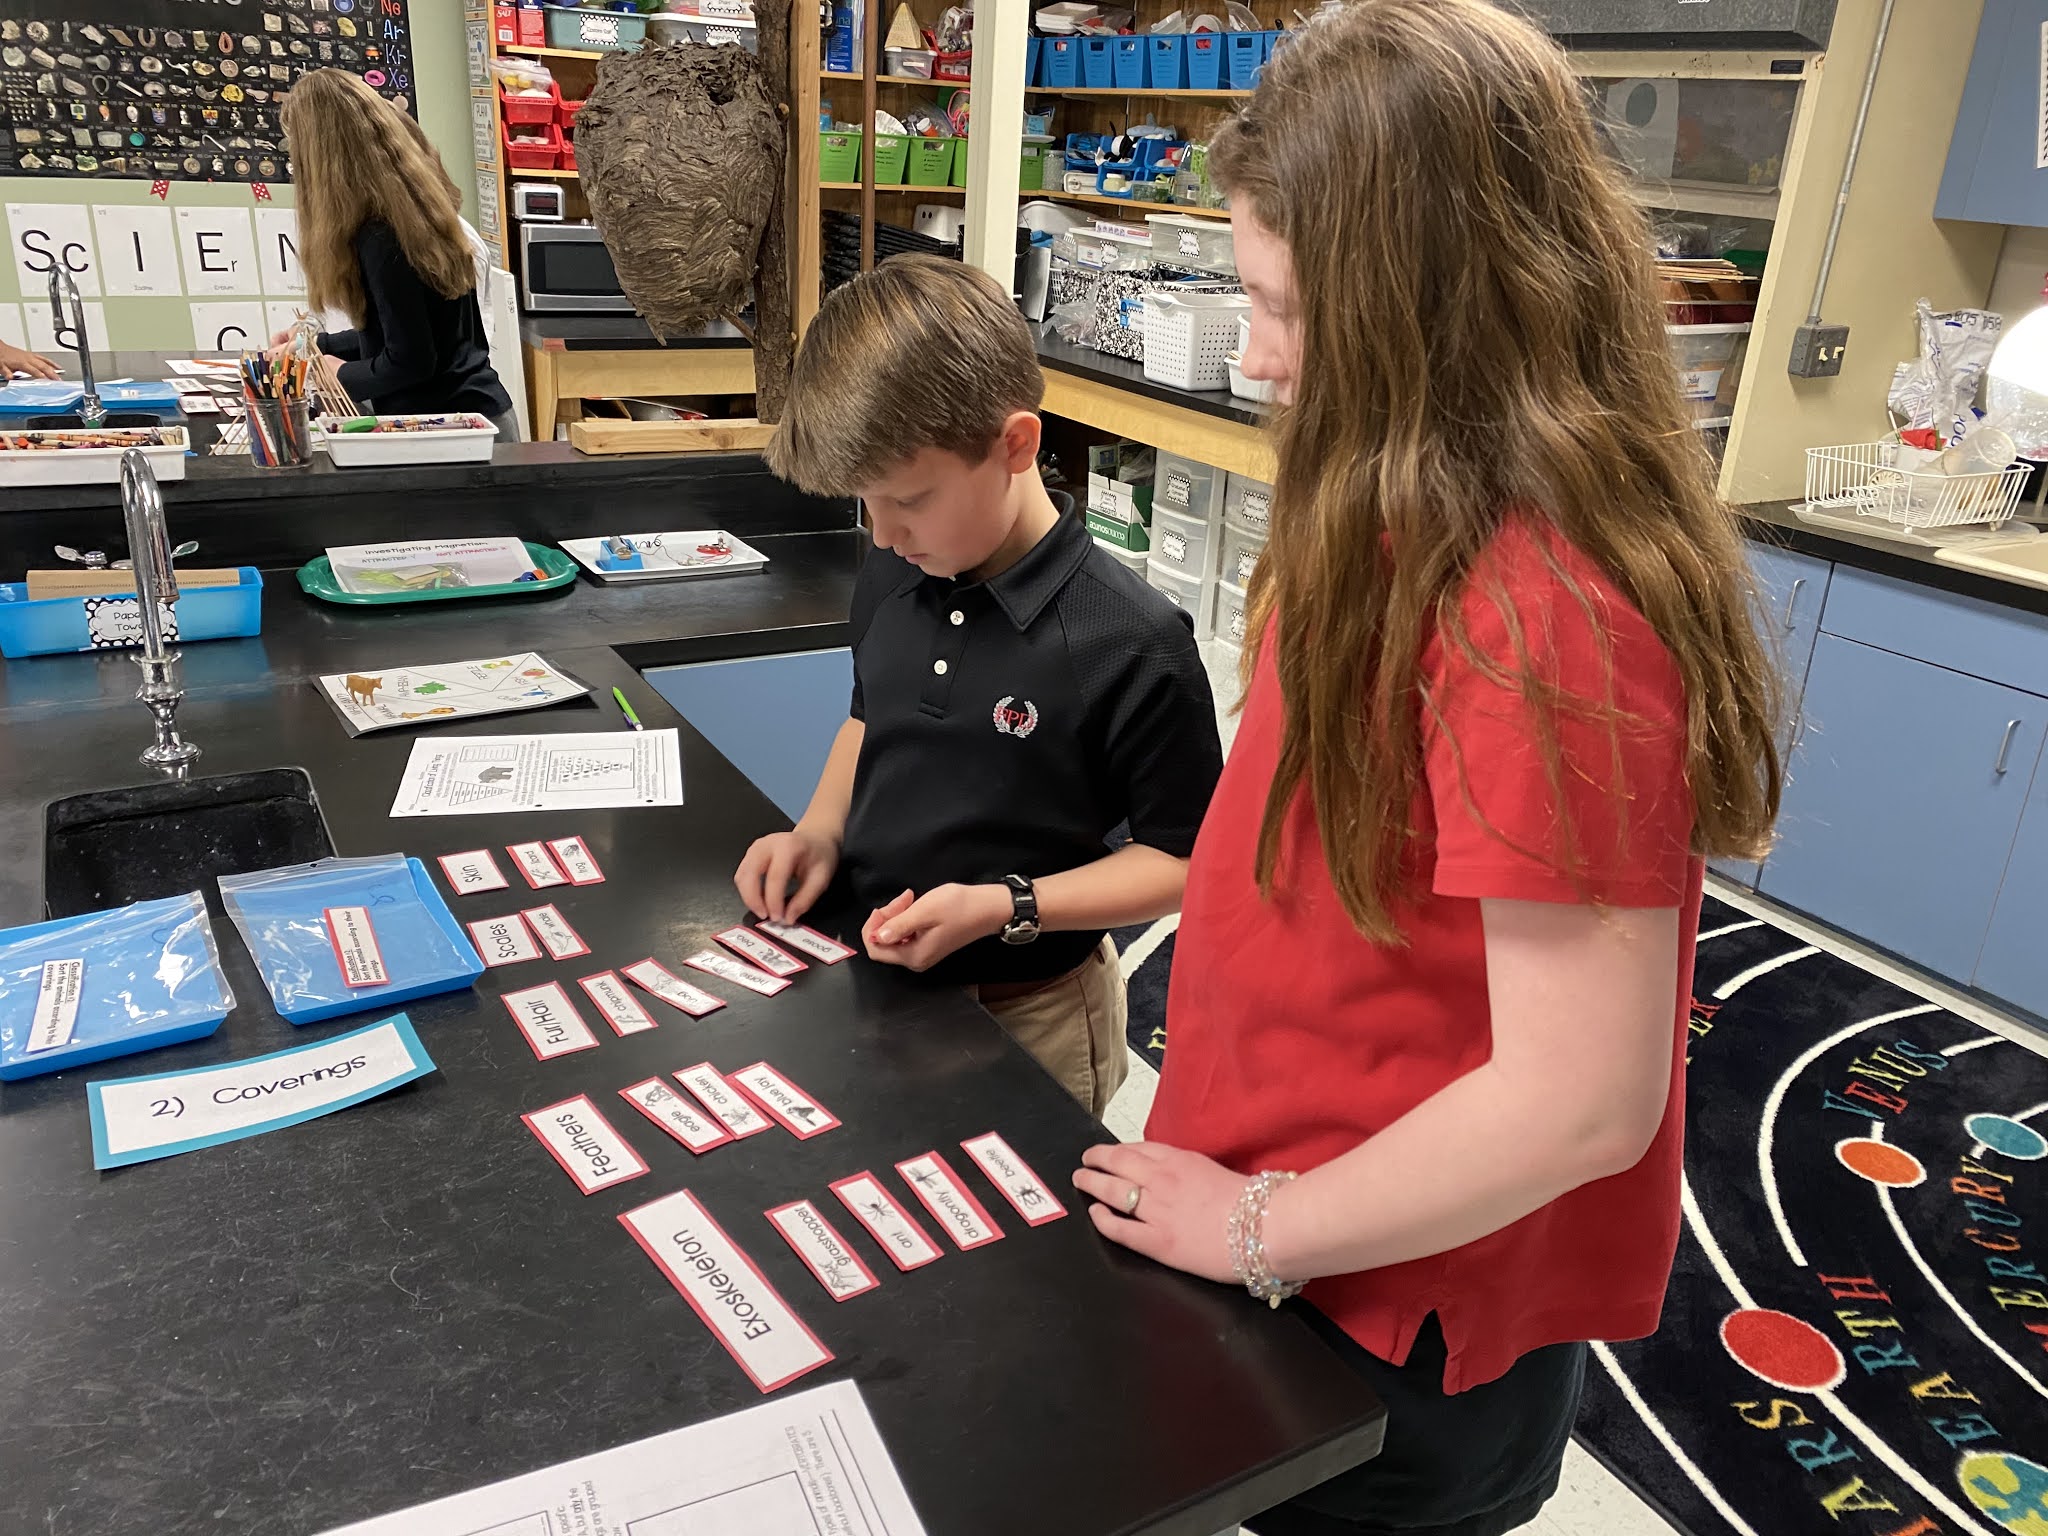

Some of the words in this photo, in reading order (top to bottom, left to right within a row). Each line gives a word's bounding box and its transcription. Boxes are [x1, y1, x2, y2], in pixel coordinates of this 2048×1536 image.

[496, 9, 512, 18] SALT
[383, 18, 405, 40] Ar
[385, 43, 407, 65] Kr
[388, 67, 409, 89] Xe
[20, 229, 89, 273] Sc
[132, 231, 144, 272] I
[195, 231, 238, 273] Er
[364, 545, 432, 555] Investigating
[434, 541, 489, 549] Magnetism
[113, 611, 140, 621] Pape
[115, 623, 143, 632] Tow
[594, 980, 627, 1012] chipmunk
[525, 999, 569, 1046] Fur/Hair
[150, 1096, 185, 1118] 2)
[212, 1055, 367, 1104] Coverings
[694, 1074, 728, 1105] chicken
[754, 1076, 776, 1093] jay
[1821, 1038, 1949, 1121] VENUS
[771, 1087, 793, 1107] blue
[670, 1110, 701, 1133] eagle
[555, 1113, 619, 1178] Feathers
[985, 1148, 1015, 1178] beetle
[936, 1190, 980, 1240] dragonfly
[794, 1206, 851, 1268] grasshopper
[891, 1230, 913, 1250] ant
[672, 1229, 773, 1342] Exoskeleton
[1816, 1271, 2002, 1450] EARTH
